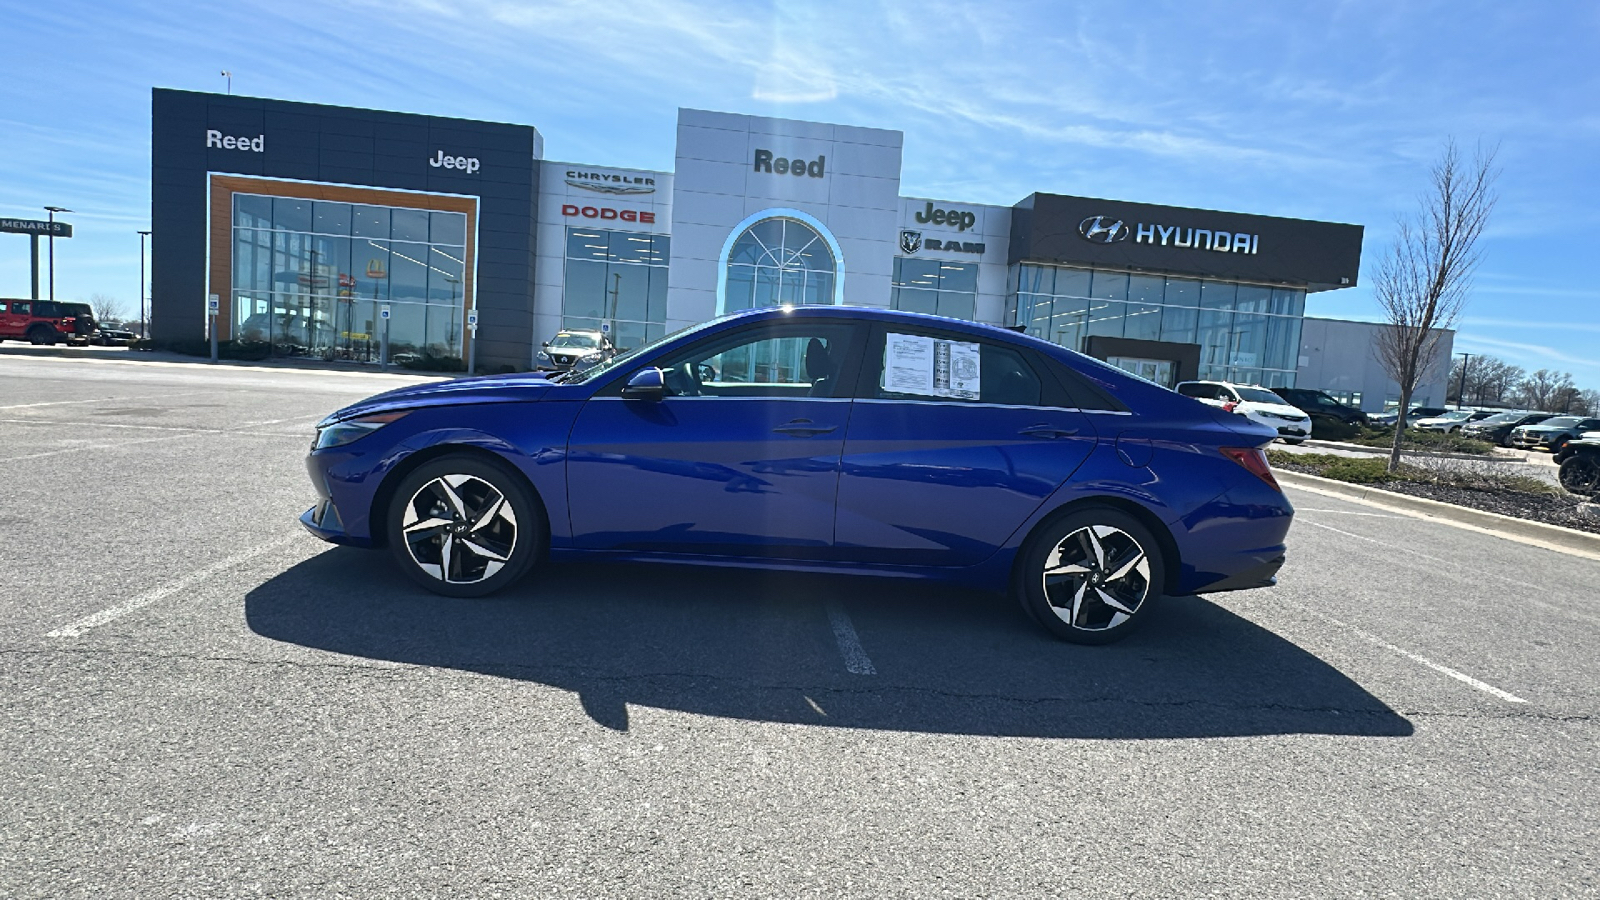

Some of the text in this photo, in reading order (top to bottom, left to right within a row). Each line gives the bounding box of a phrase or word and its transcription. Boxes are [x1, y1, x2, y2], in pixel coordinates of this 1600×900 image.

[206, 129, 264, 152] Reed
[429, 150, 480, 174] Jeep
[754, 148, 826, 179] Reed
[566, 171, 655, 186] CHRYSLER
[562, 204, 655, 224] DODGE
[915, 202, 976, 232] Jeep
[924, 238, 986, 254] RAM
[1136, 222, 1259, 254] HYUNDAI
